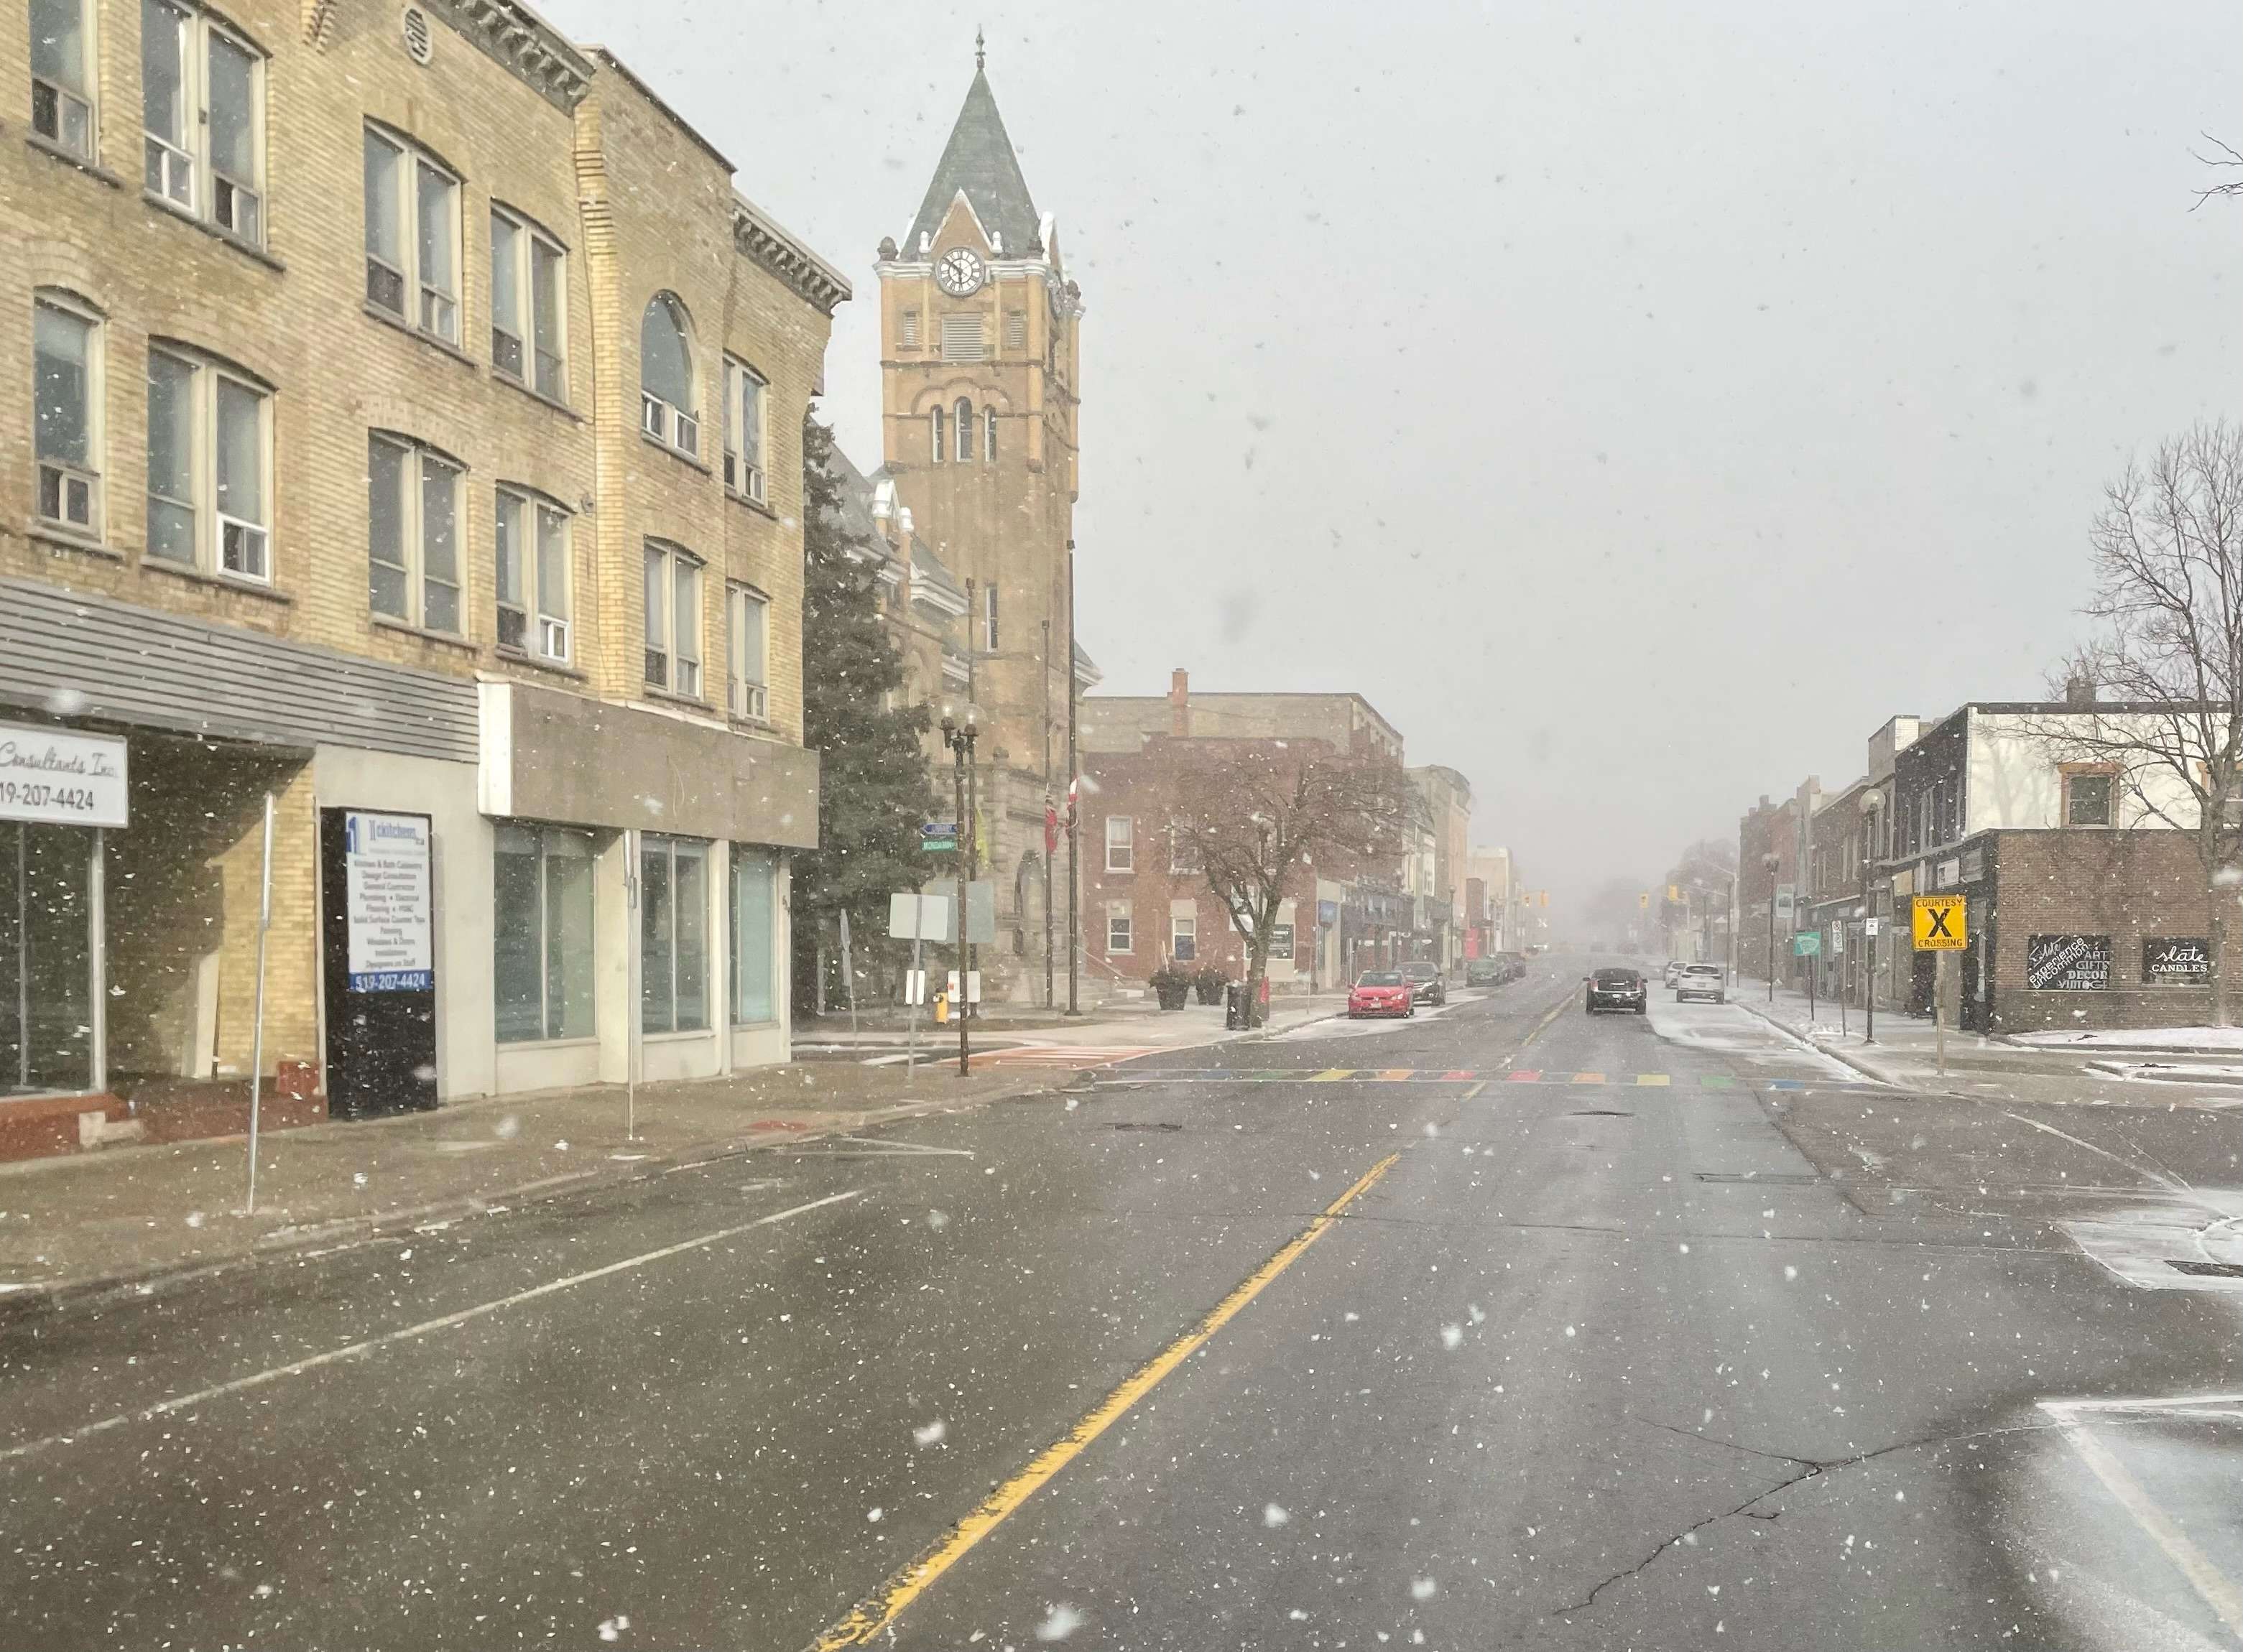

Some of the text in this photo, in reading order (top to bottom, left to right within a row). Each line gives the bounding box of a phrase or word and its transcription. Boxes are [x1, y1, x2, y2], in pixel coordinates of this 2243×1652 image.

[1915, 899, 1962, 907] COURTESY
[1928, 909, 1952, 937] X
[1918, 939, 1962, 947] CROSSING
[2029, 938, 2084, 984] experience
[2084, 951, 2107, 960] ART
[2156, 946, 2208, 962] slate
[2032, 943, 2089, 989] uncommon
